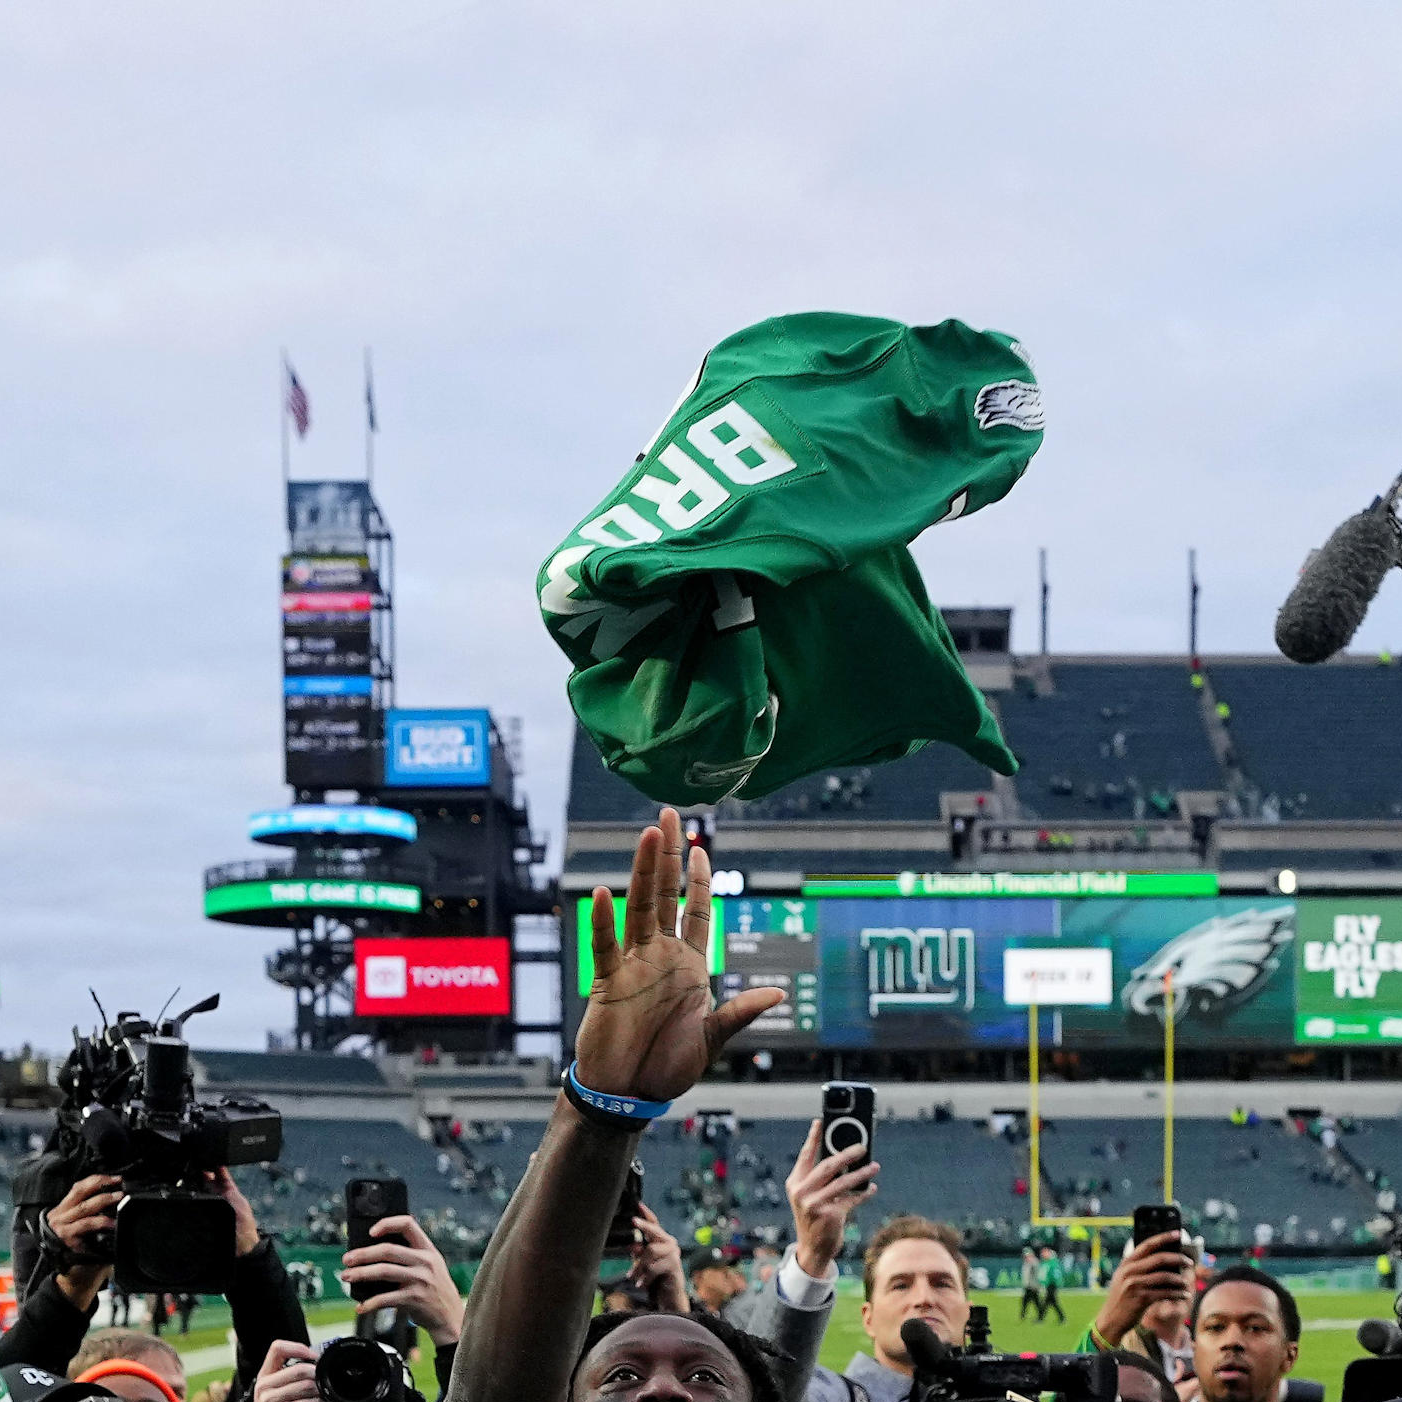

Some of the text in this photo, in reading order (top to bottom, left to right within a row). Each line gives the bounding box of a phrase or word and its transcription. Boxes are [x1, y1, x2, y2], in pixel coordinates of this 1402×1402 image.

[409, 726, 465, 745] BUD
[399, 745, 474, 765] LIGHT
[1334, 915, 1381, 943] FLY
[409, 966, 499, 988] TOYOTA
[1334, 970, 1381, 998] FLY
